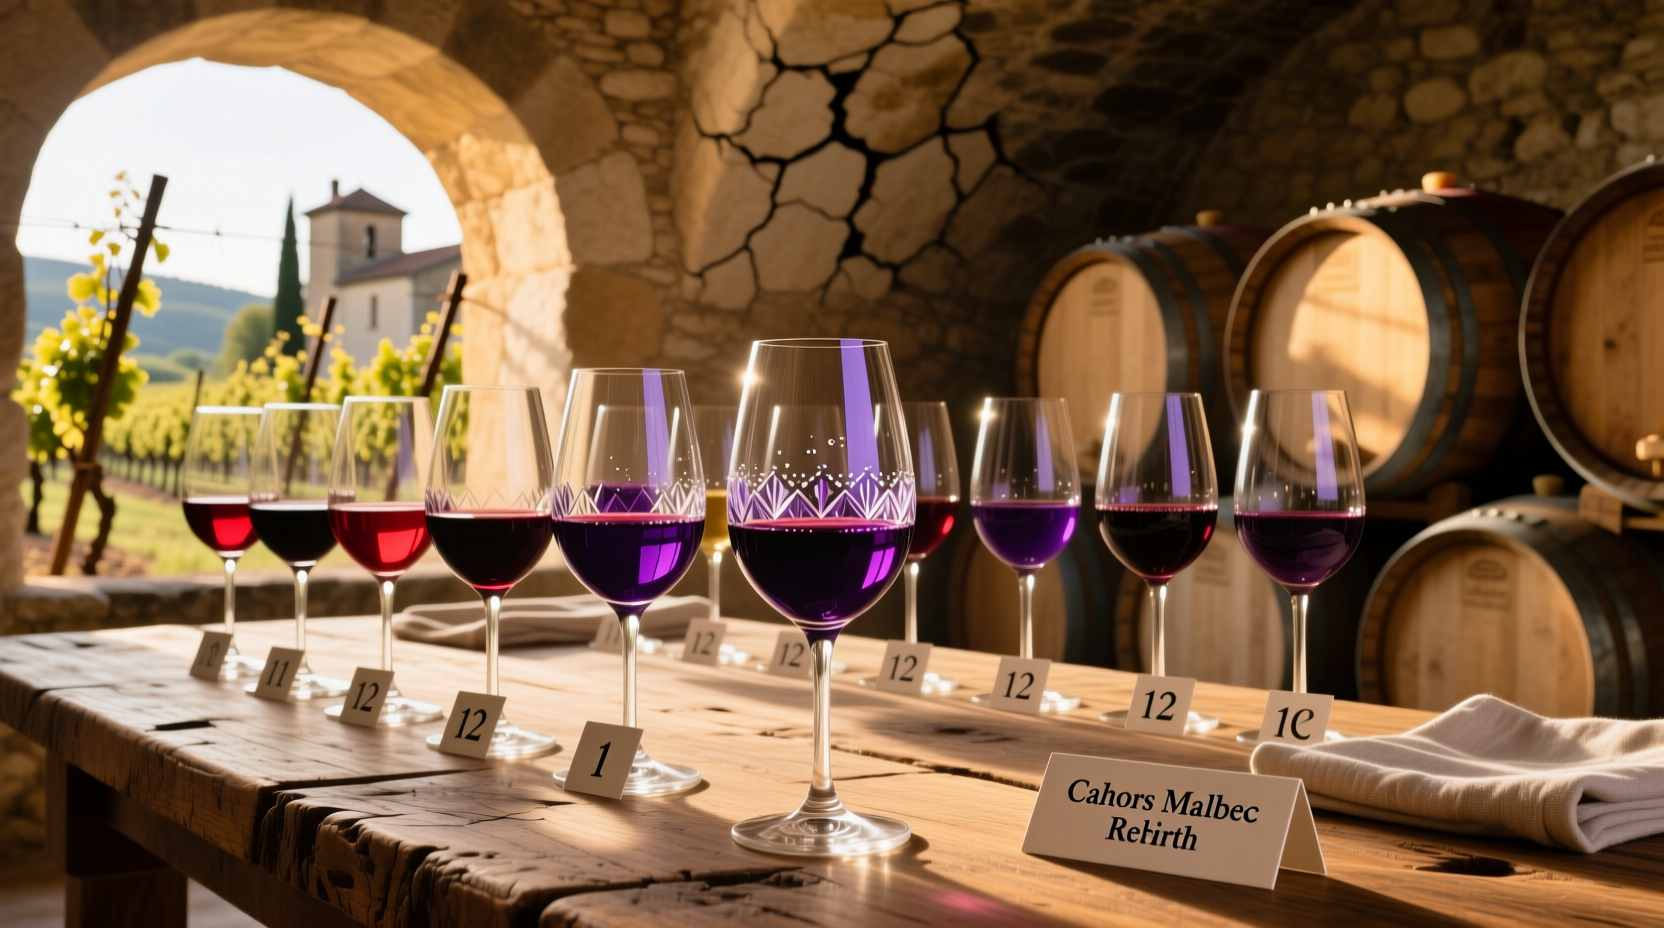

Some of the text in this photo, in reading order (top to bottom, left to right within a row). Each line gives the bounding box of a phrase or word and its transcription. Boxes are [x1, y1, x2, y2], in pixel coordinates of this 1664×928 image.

[690, 630, 716, 656] 12
[779, 641, 806, 668] 12
[265, 658, 290, 688] 11
[887, 654, 919, 683] 12
[351, 681, 380, 713] 12
[1002, 670, 1035, 701] 12
[1141, 690, 1177, 722] 12
[454, 707, 487, 742] 12
[590, 741, 612, 778] 1
[1067, 779, 1260, 823] Cahors Malbec
